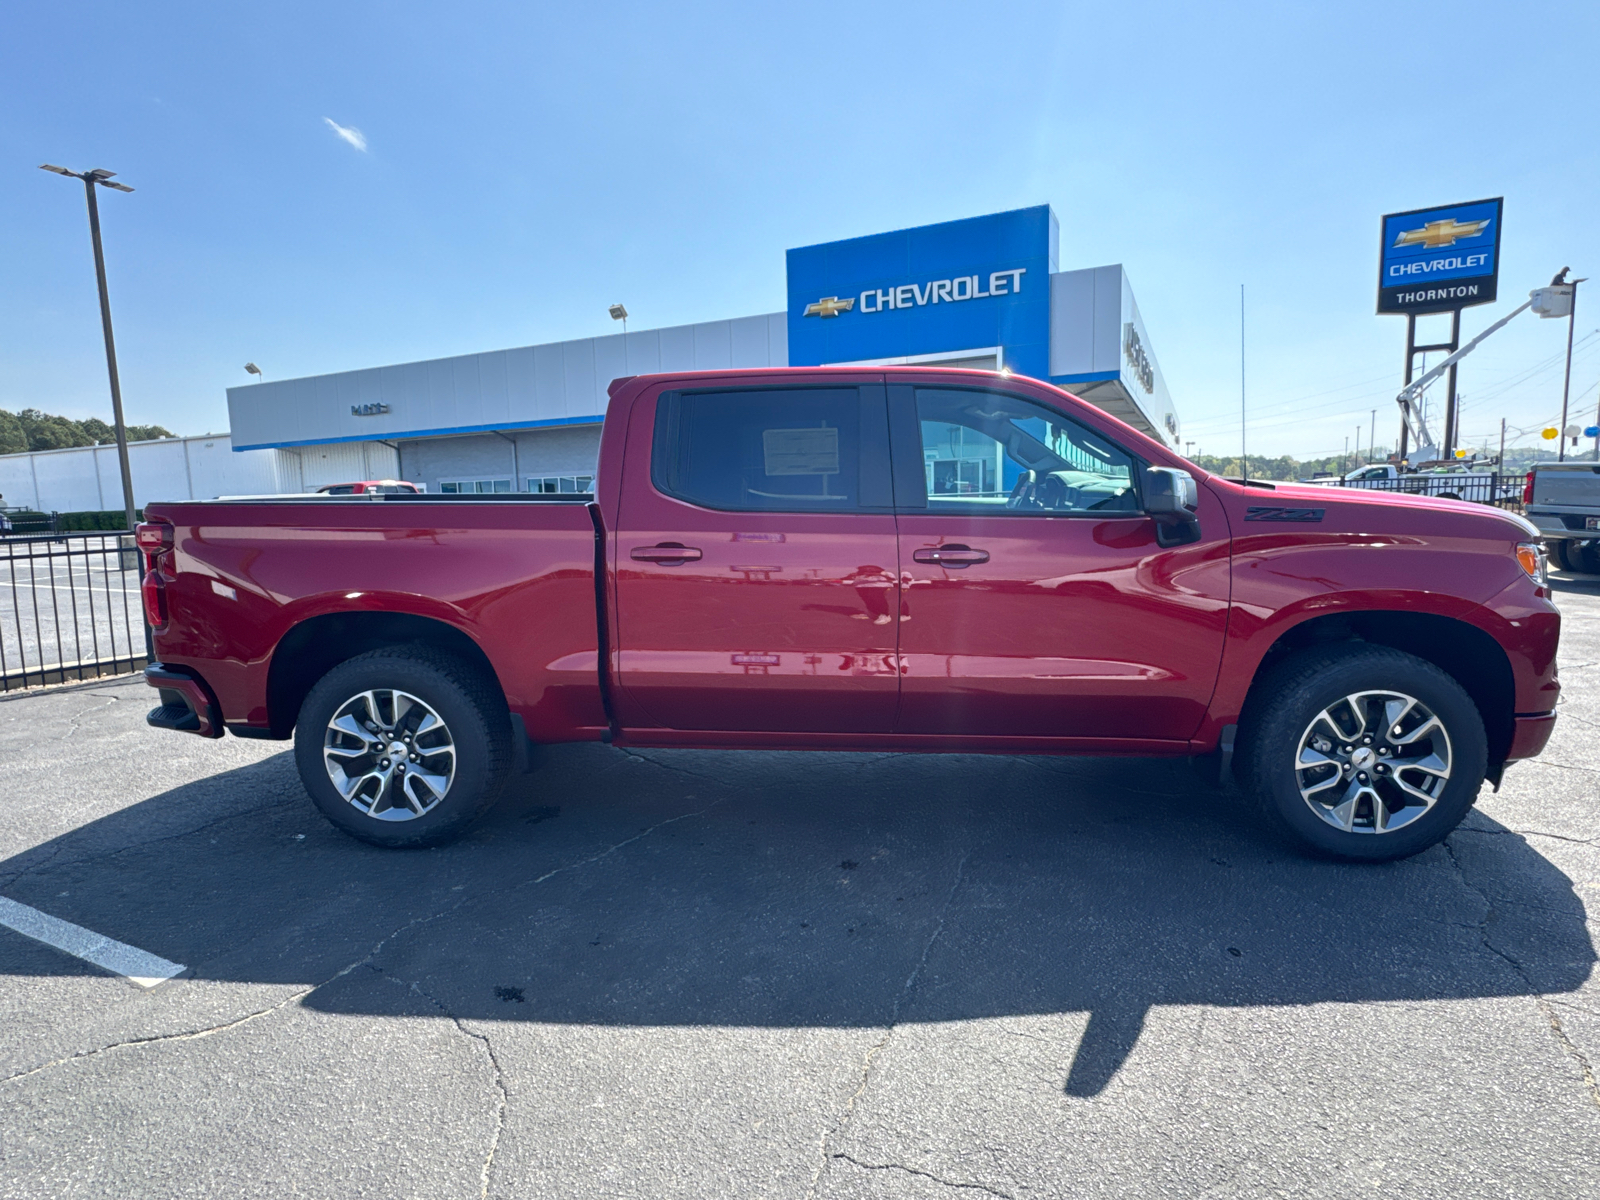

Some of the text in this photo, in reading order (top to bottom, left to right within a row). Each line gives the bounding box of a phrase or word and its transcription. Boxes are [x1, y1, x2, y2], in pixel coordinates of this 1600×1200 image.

[1389, 254, 1488, 277] CHEVROLET
[860, 268, 1027, 314] CHEVROLET
[1396, 285, 1478, 304] THORNTON
[1243, 506, 1326, 523] Z71
